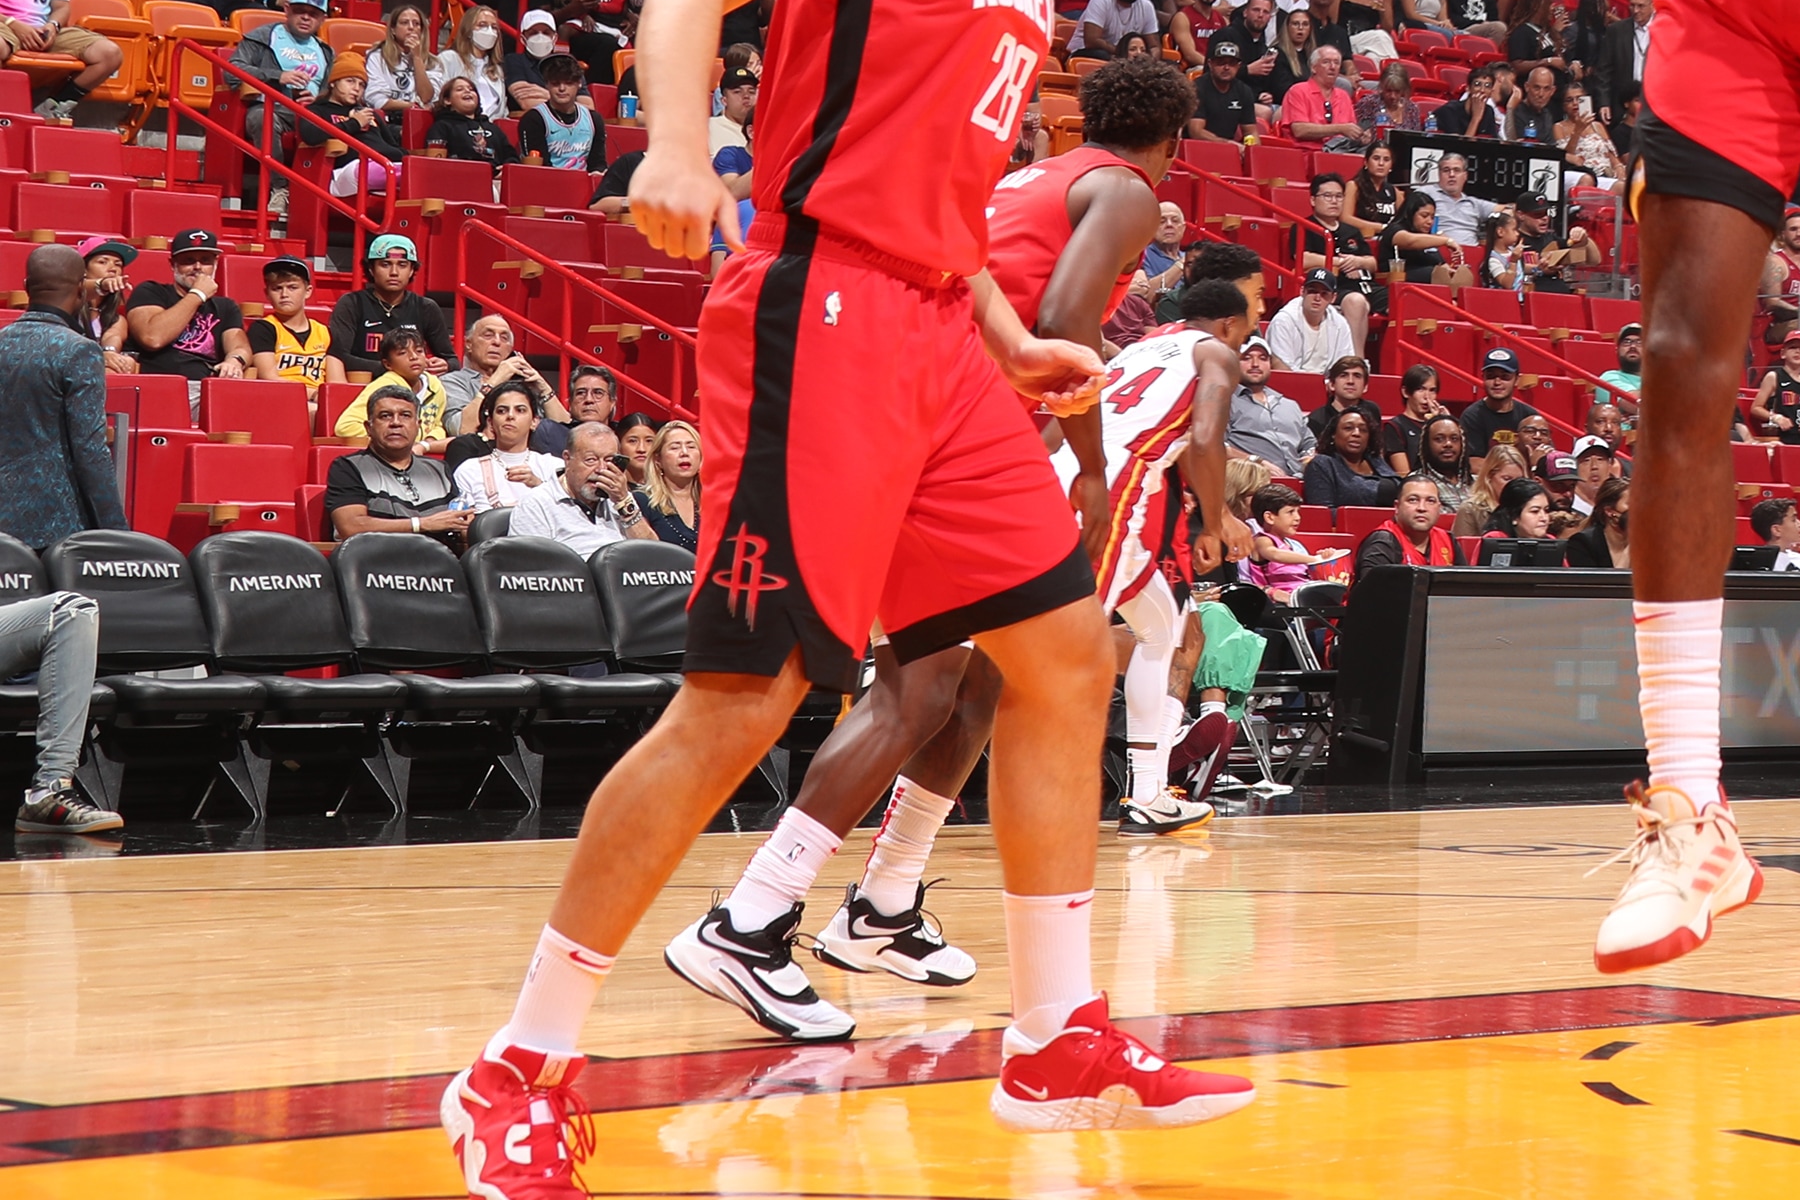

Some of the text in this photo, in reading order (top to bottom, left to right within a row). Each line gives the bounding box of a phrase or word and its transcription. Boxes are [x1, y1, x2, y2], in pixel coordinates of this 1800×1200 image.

[970, 32, 1039, 142] 28
[548, 140, 591, 156] Miami
[278, 354, 324, 370] HEAT
[81, 558, 181, 580] AMERANT
[229, 572, 323, 593] AMERANT
[365, 572, 456, 595] AMERANT
[499, 573, 586, 595] AMERANT
